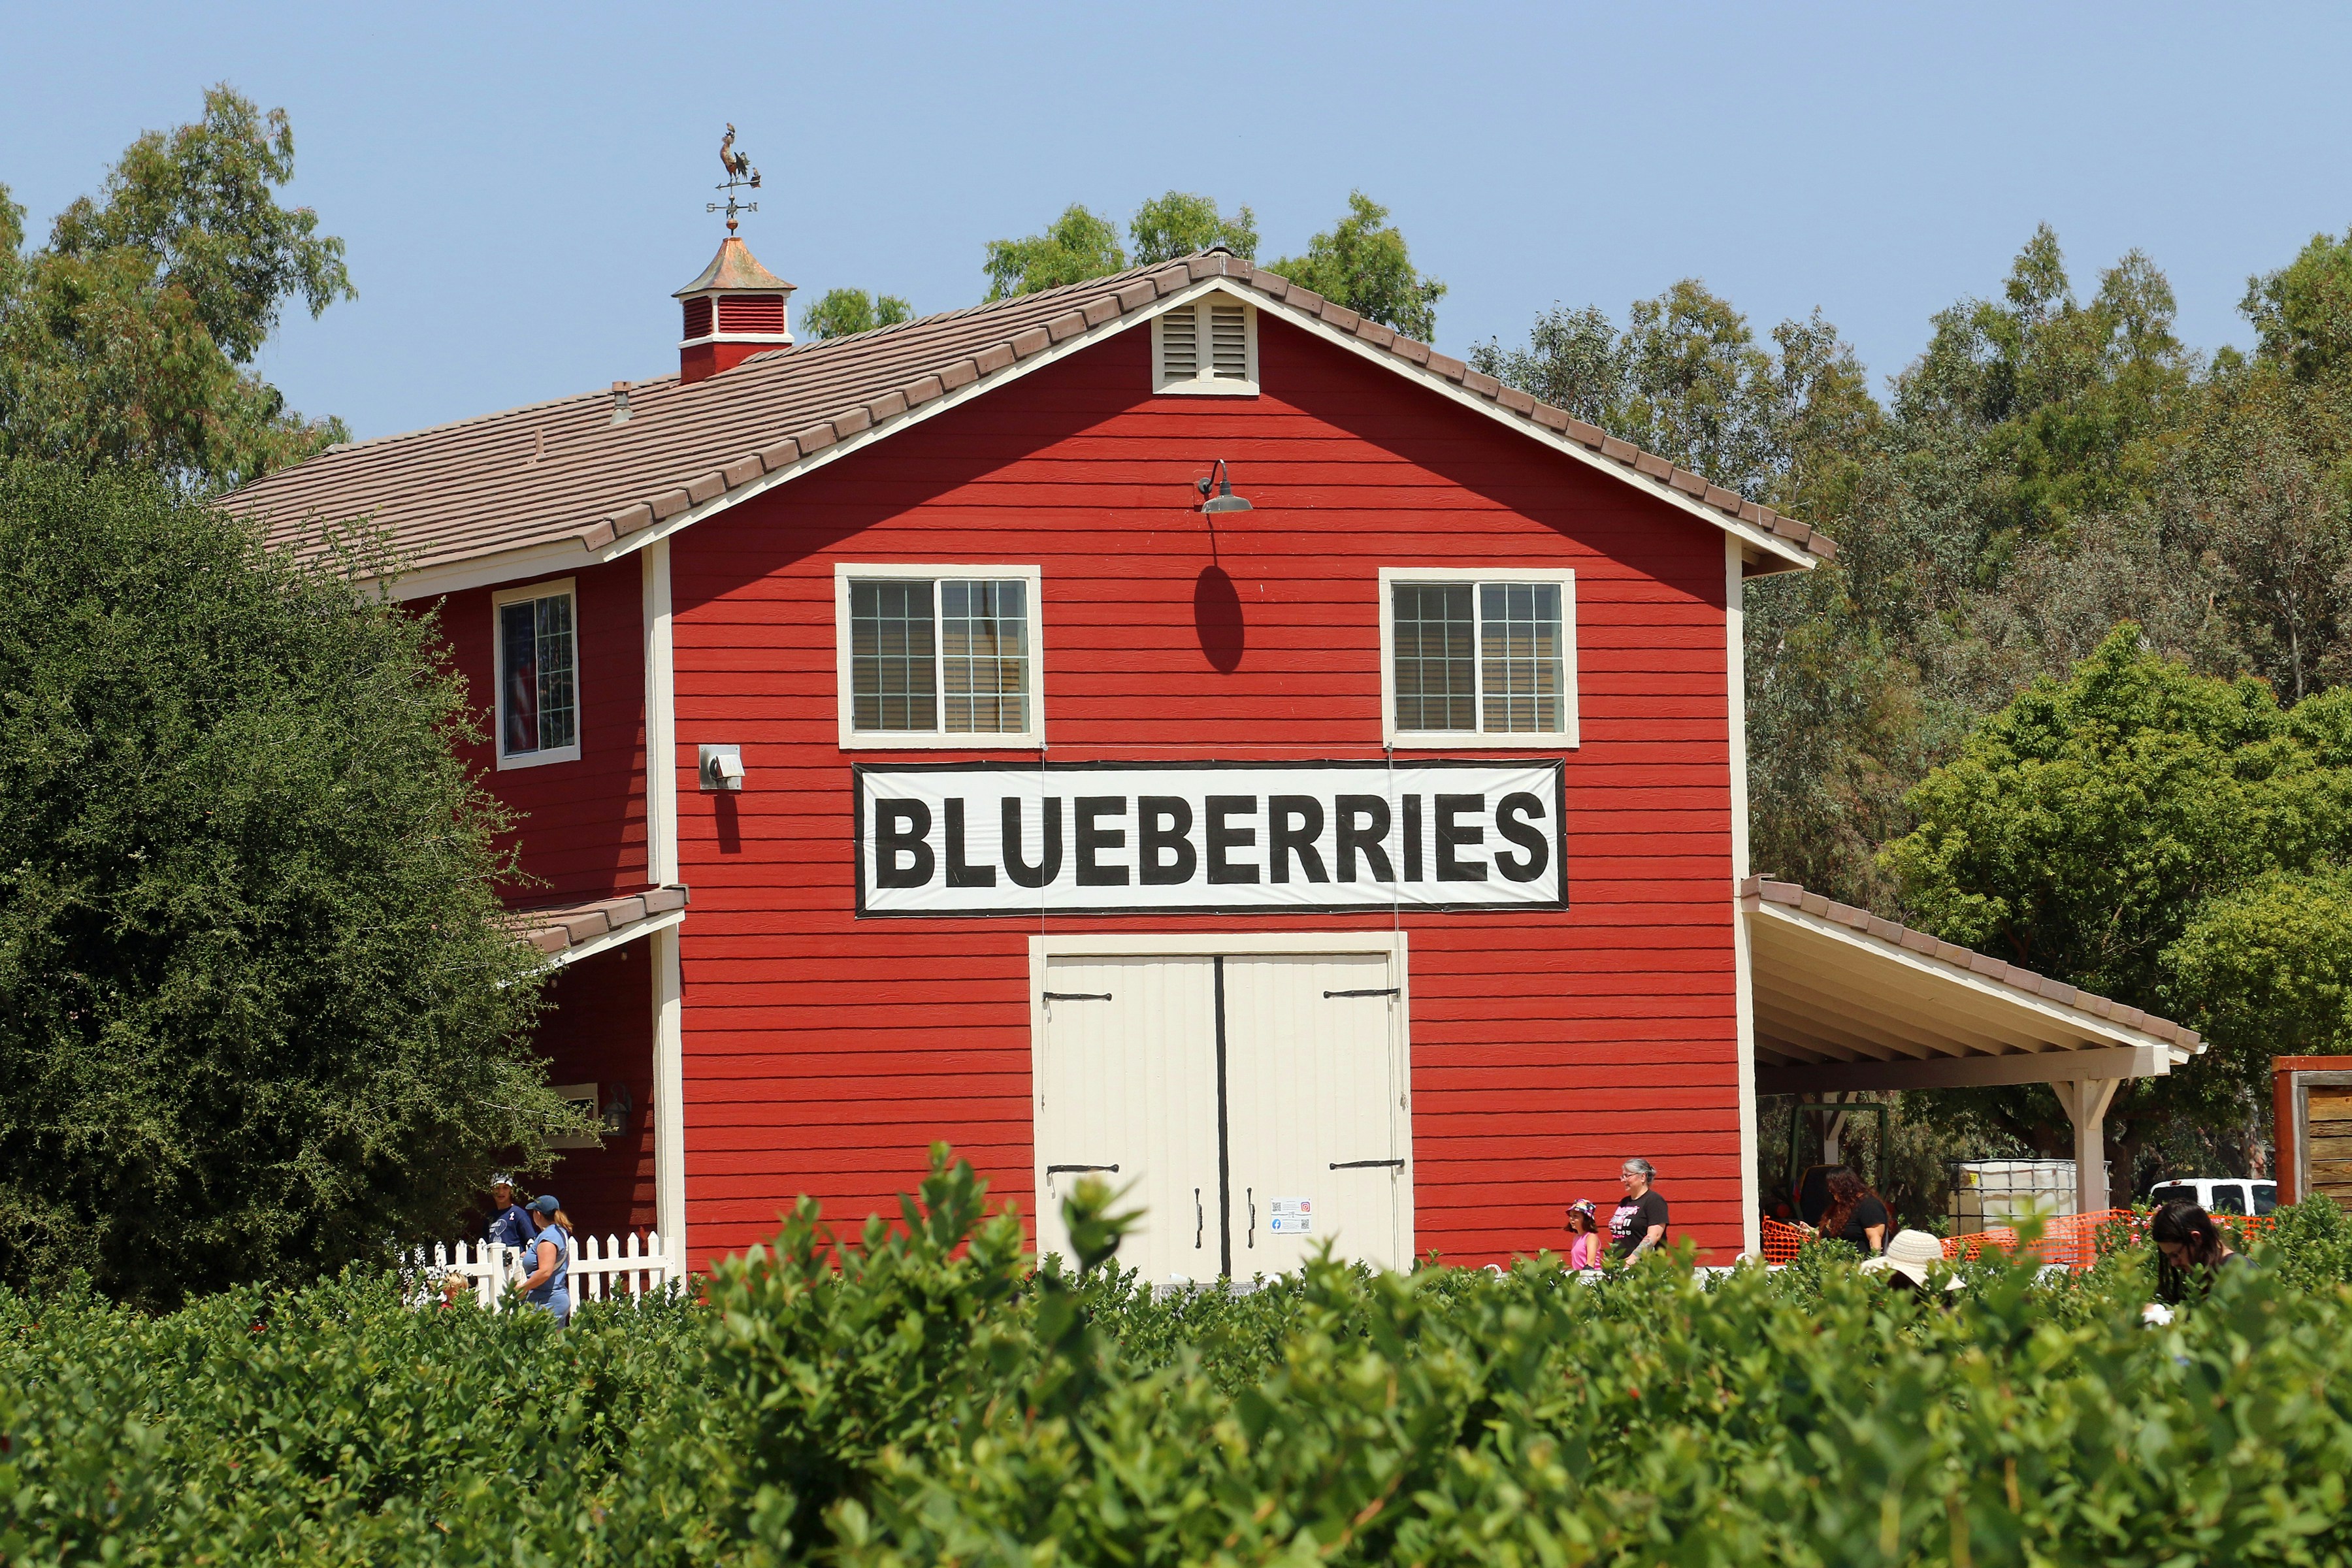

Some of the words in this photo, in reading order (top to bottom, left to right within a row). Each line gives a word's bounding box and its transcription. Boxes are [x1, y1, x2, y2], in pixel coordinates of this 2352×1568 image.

[707, 203, 715, 213] S
[748, 203, 758, 212] N
[875, 792, 1549, 889] BLUEBERRIES
